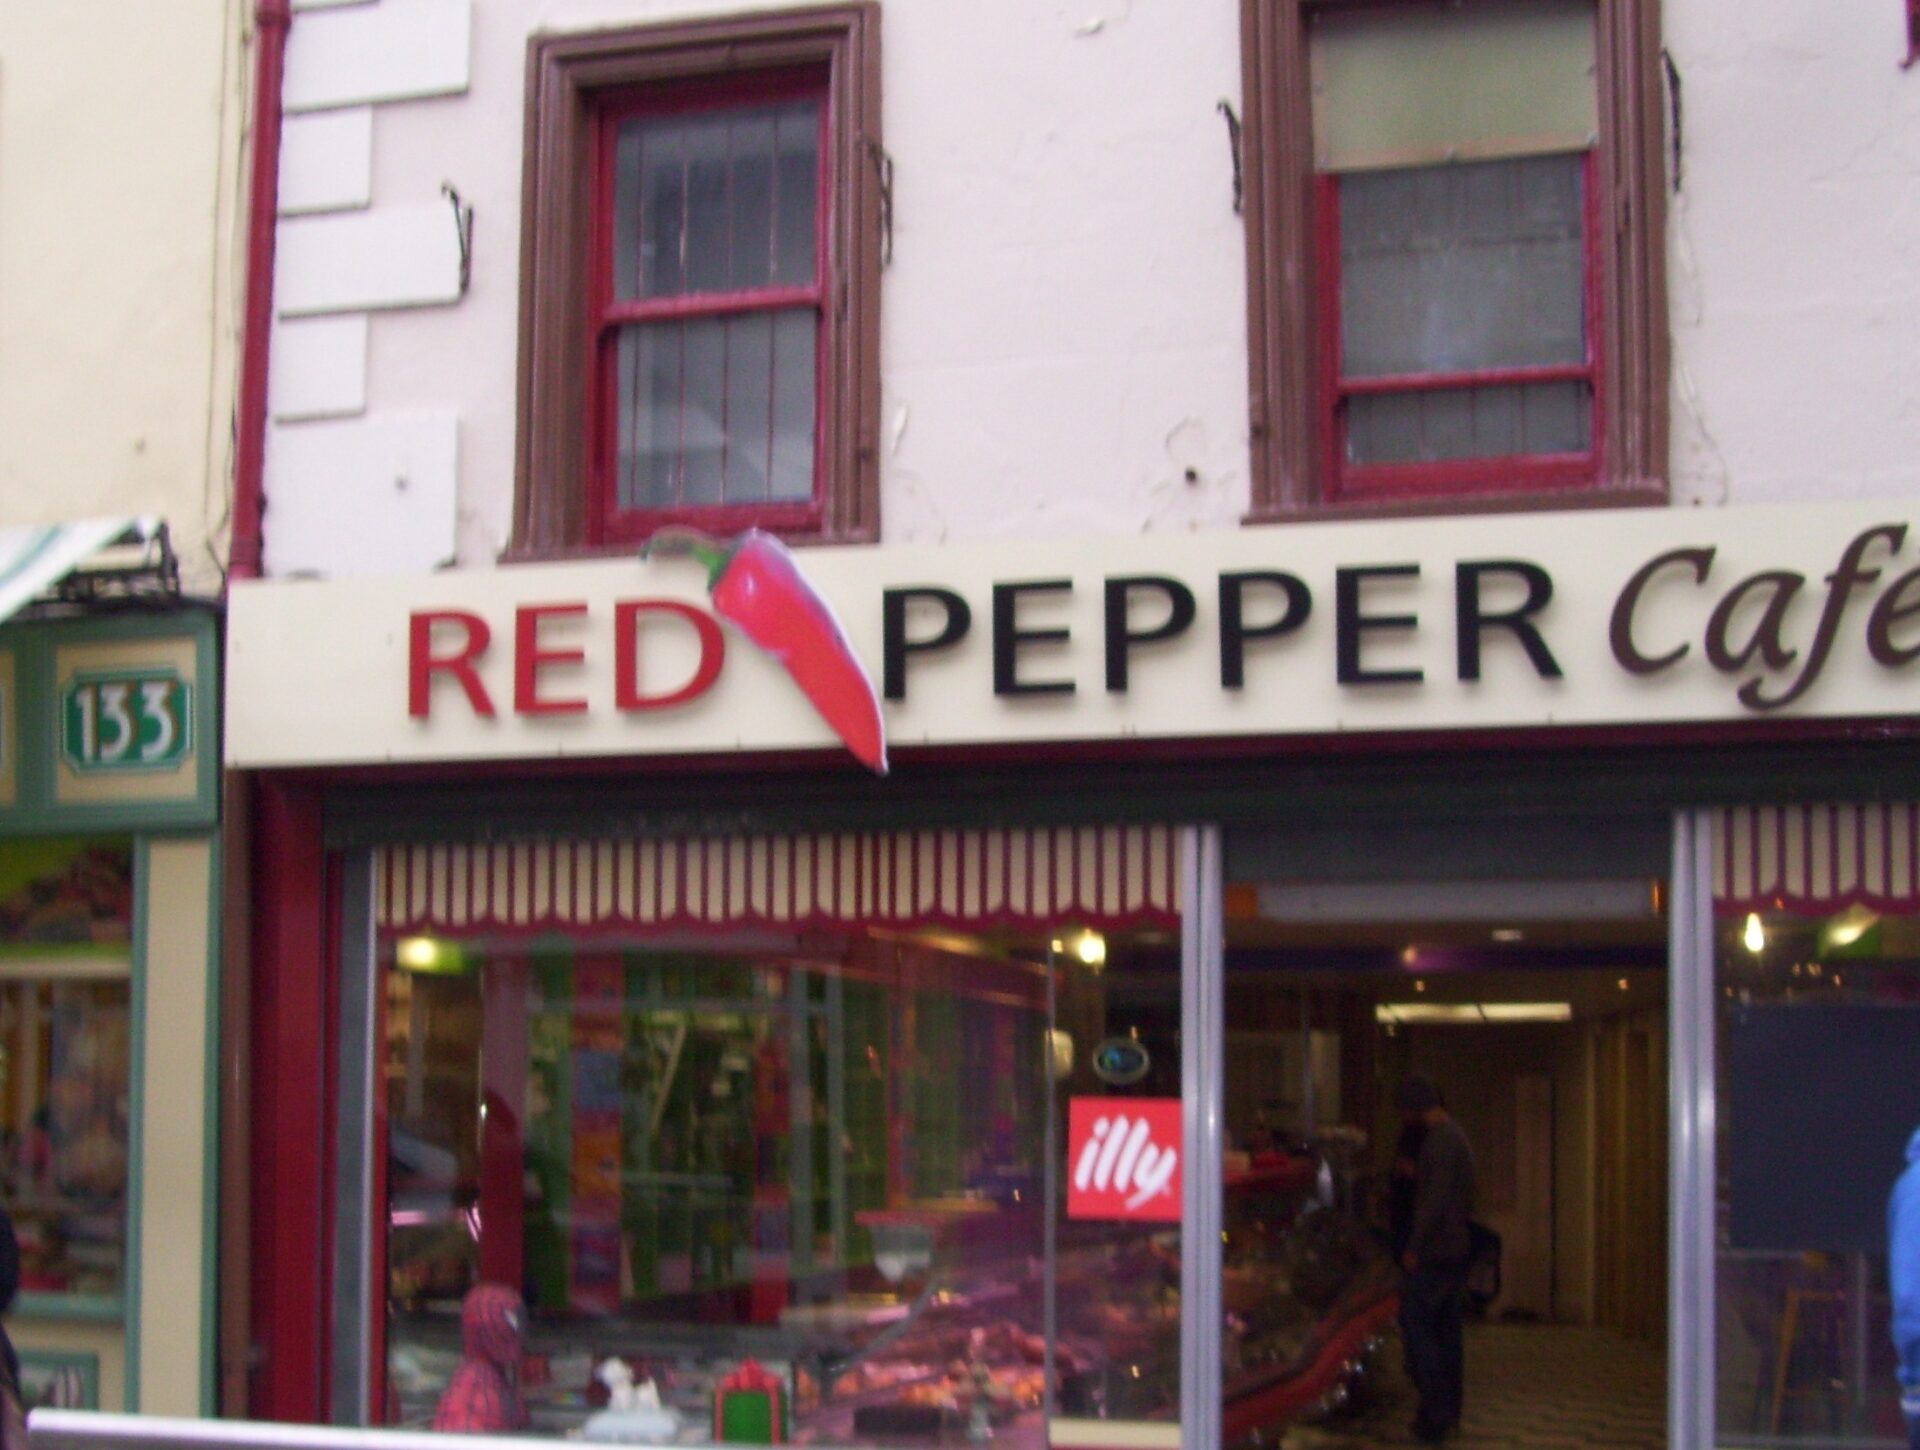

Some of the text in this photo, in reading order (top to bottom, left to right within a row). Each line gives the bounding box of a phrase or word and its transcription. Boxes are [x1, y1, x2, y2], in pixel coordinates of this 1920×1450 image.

[408, 597, 725, 718] RED
[882, 559, 1564, 703] PEPPER
[76, 680, 180, 763] 133
[1074, 1114, 1176, 1210] illy
